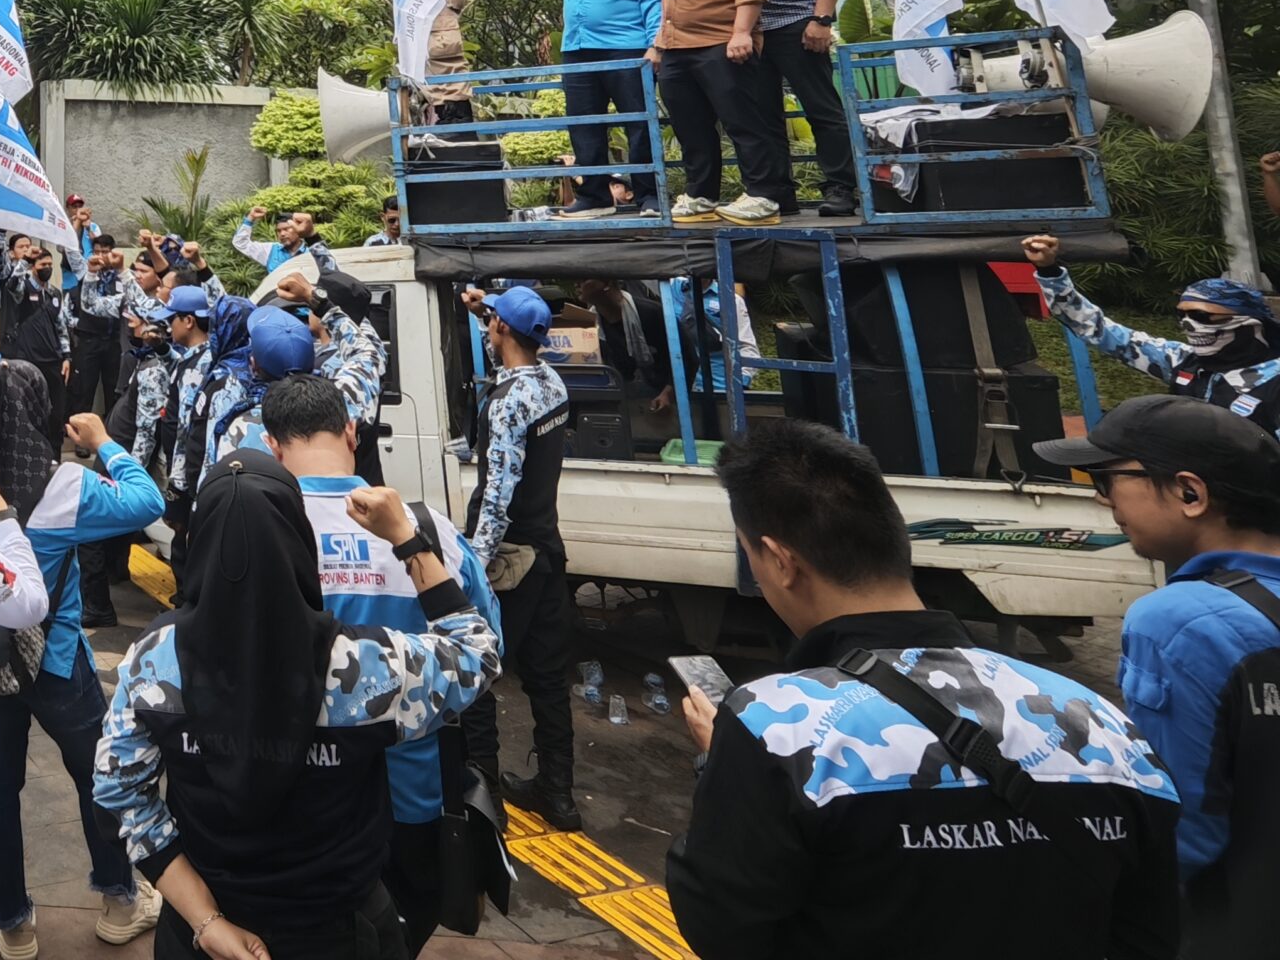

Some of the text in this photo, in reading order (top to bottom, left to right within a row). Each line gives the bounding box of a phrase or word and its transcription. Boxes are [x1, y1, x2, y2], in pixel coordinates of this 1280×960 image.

[944, 531, 979, 540] SUPER
[981, 531, 1041, 541] CARGO
[319, 572, 386, 586] ROVINSI BANTEN
[810, 697, 853, 748] LASKAR
[899, 816, 1127, 849] LASKAR NANAL
